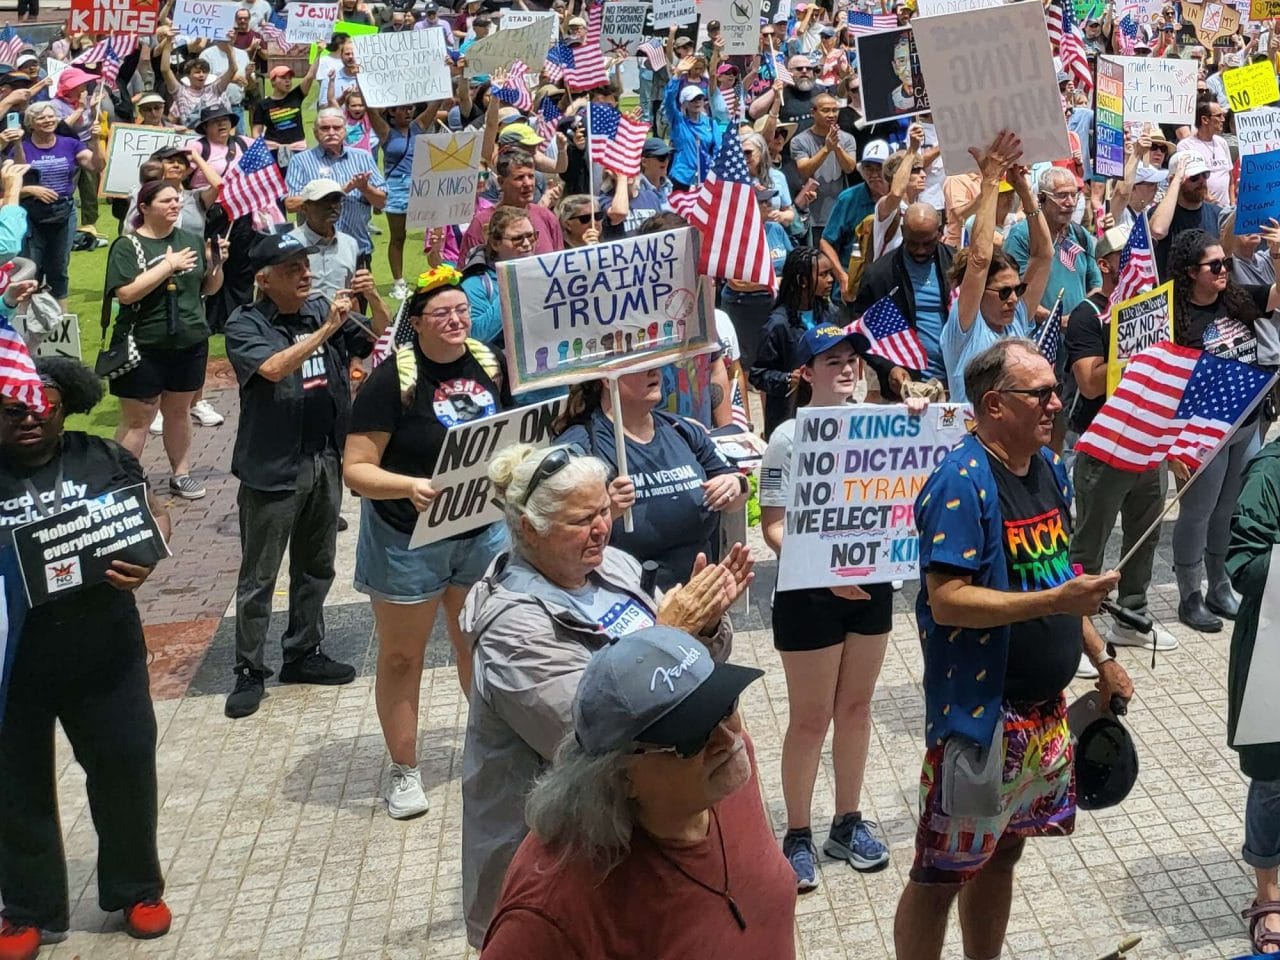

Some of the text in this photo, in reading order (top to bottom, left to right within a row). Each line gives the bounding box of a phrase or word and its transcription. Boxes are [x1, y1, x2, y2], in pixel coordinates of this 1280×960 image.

[184, 2, 222, 17] LOVE
[508, 15, 532, 23] STAND
[604, 14, 644, 24] NO CROWNS
[605, 5, 645, 14] NO THRONES
[655, 6, 695, 21] COMPLIANCE
[1187, 7, 1233, 30] IN MY
[71, 9, 156, 33] KINGS
[191, 17, 212, 25] NOT
[603, 23, 642, 35] NO KINGS
[178, 23, 224, 39] HATE
[354, 34, 387, 54] WHEN
[357, 54, 409, 73] BECOMES
[1128, 60, 1177, 73] made the
[366, 66, 431, 87] COMPASSION
[405, 77, 449, 100] RADICAL
[1150, 80, 1173, 102] king
[1154, 95, 1195, 114] in 1776
[1230, 90, 1251, 110] NO
[1098, 126, 1116, 143] SEXIST
[1240, 130, 1270, 147] scare
[1098, 144, 1111, 158] NAZI
[410, 179, 429, 197] NO
[448, 203, 472, 218] 1776
[1240, 200, 1276, 212] became
[538, 233, 676, 278] VETERANS
[544, 257, 678, 304] AGAINST
[543, 283, 673, 330] TRUMP
[1122, 307, 1135, 320] We
[1117, 314, 1155, 341] SAY NO
[1136, 326, 1171, 352] KINGS
[848, 414, 921, 440] KINGS
[438, 419, 509, 476] NOT
[646, 474, 655, 486] A
[843, 476, 926, 502] TYRAN
[645, 489, 650, 497] A
[651, 486, 674, 498] SUCKER
[101, 502, 126, 520] free
[428, 476, 491, 528] OUR
[821, 504, 891, 531] ELECT
[43, 522, 125, 561] everybody's
[1007, 514, 1069, 559] FUCK
[830, 541, 882, 568] NOT
[57, 575, 73, 584] NO
[1012, 550, 1076, 592] TRUM
[650, 645, 701, 692] Fender
